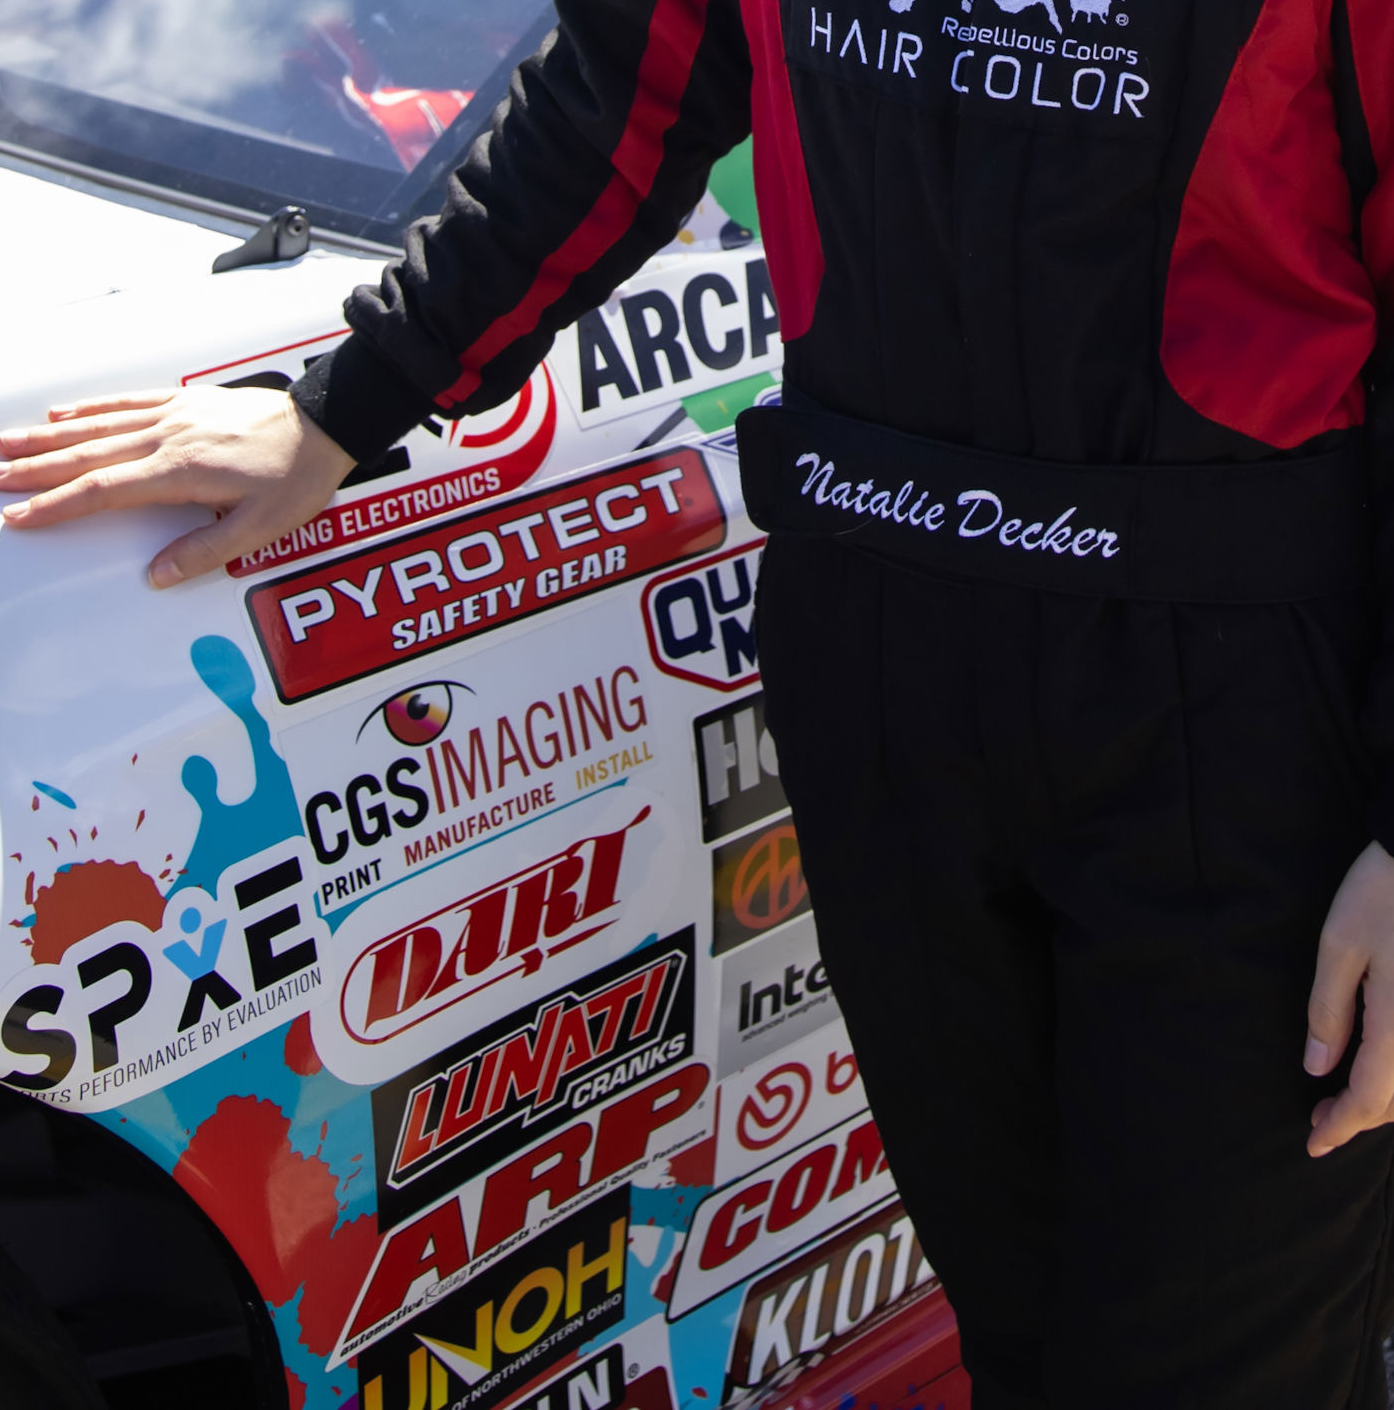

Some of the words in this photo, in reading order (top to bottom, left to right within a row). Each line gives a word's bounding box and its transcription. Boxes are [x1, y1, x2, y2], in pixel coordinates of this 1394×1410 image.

[811, 6, 924, 79] HAIR
[950, 49, 1150, 119] COLOR
[1061, 38, 1139, 66] Colors
[577, 258, 782, 413] ARCA
[278, 467, 684, 644] PYROTECT
[339, 467, 502, 537] ELECTRONICS
[795, 452, 946, 532] Natalie
[956, 489, 1121, 559] Decker
[391, 578, 526, 650] SAFETY
[535, 544, 628, 600] GEAR
[320, 858, 383, 906] PRINT
[403, 781, 556, 867] MANUFACTURE
[575, 741, 654, 790] INSTALL
[363, 804, 653, 1035] DART
[79, 1036, 198, 1101] PEFORMANCE
[202, 1017, 222, 1047] BY
[227, 966, 323, 1032] EVALUATION
[395, 958, 671, 1175] LUNATI
[571, 1032, 687, 1110] CRANKS
[342, 1062, 711, 1345] ARP
[468, 1226, 531, 1275] Products
[538, 1179, 609, 1229] Professional
[609, 1157, 650, 1186] Quality
[471, 1315, 585, 1403] NORTHWESTERN
[586, 1292, 623, 1322] OHIO
